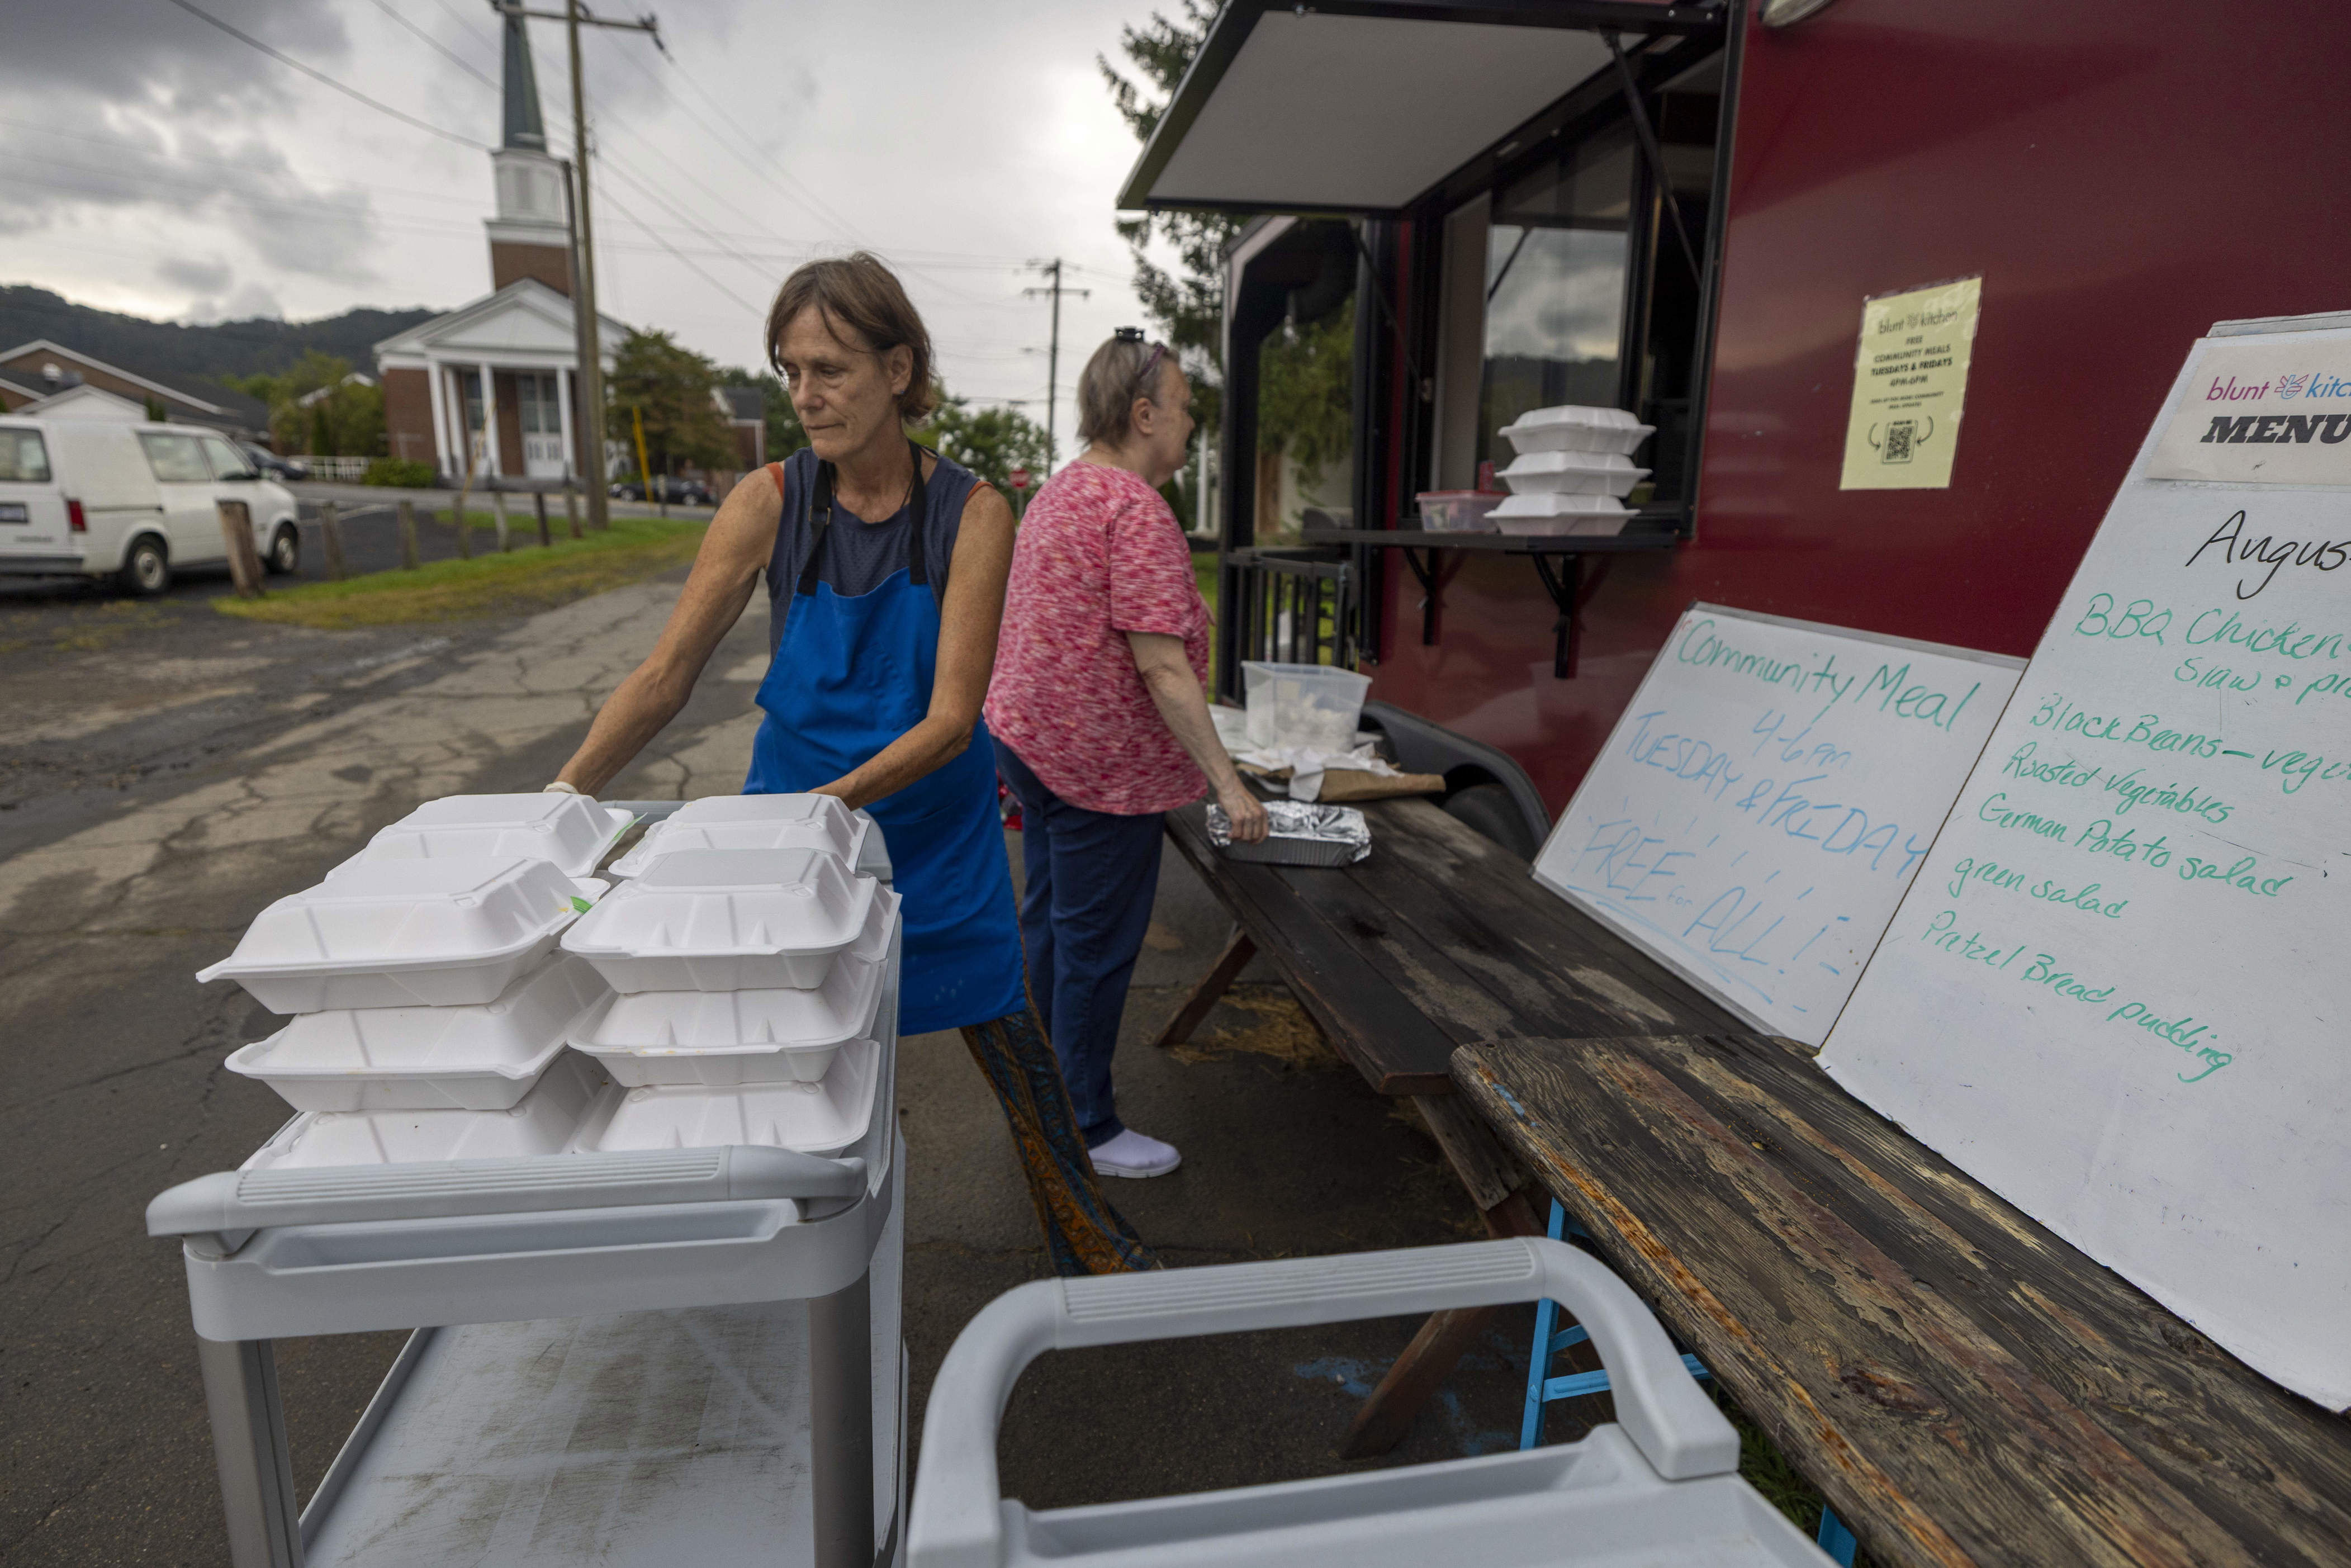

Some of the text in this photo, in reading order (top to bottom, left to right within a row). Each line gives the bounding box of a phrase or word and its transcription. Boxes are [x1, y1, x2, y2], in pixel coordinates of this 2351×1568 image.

[1874, 344, 1951, 363] COMMUNITY MEALS
[1878, 318, 1904, 335] blunt
[1906, 335, 1923, 345] FREE
[1871, 357, 1953, 376] TUESDAYS & FRIDAYS
[2206, 372, 2351, 401] blunt kitc
[2200, 414, 2351, 444] MENU
[2185, 510, 2351, 600] Augus
[2070, 592, 2343, 660] BBQ Chicken
[1677, 619, 1981, 732] Community Meal
[1624, 710, 1744, 803] TUESDAY
[1757, 773, 1932, 879] FRIDAY
[1979, 792, 2068, 842] German
[1571, 818, 1696, 901] FREE
[1947, 858, 2129, 918] green salad
[1921, 910, 2233, 1083] Pretzel Bread pudding
